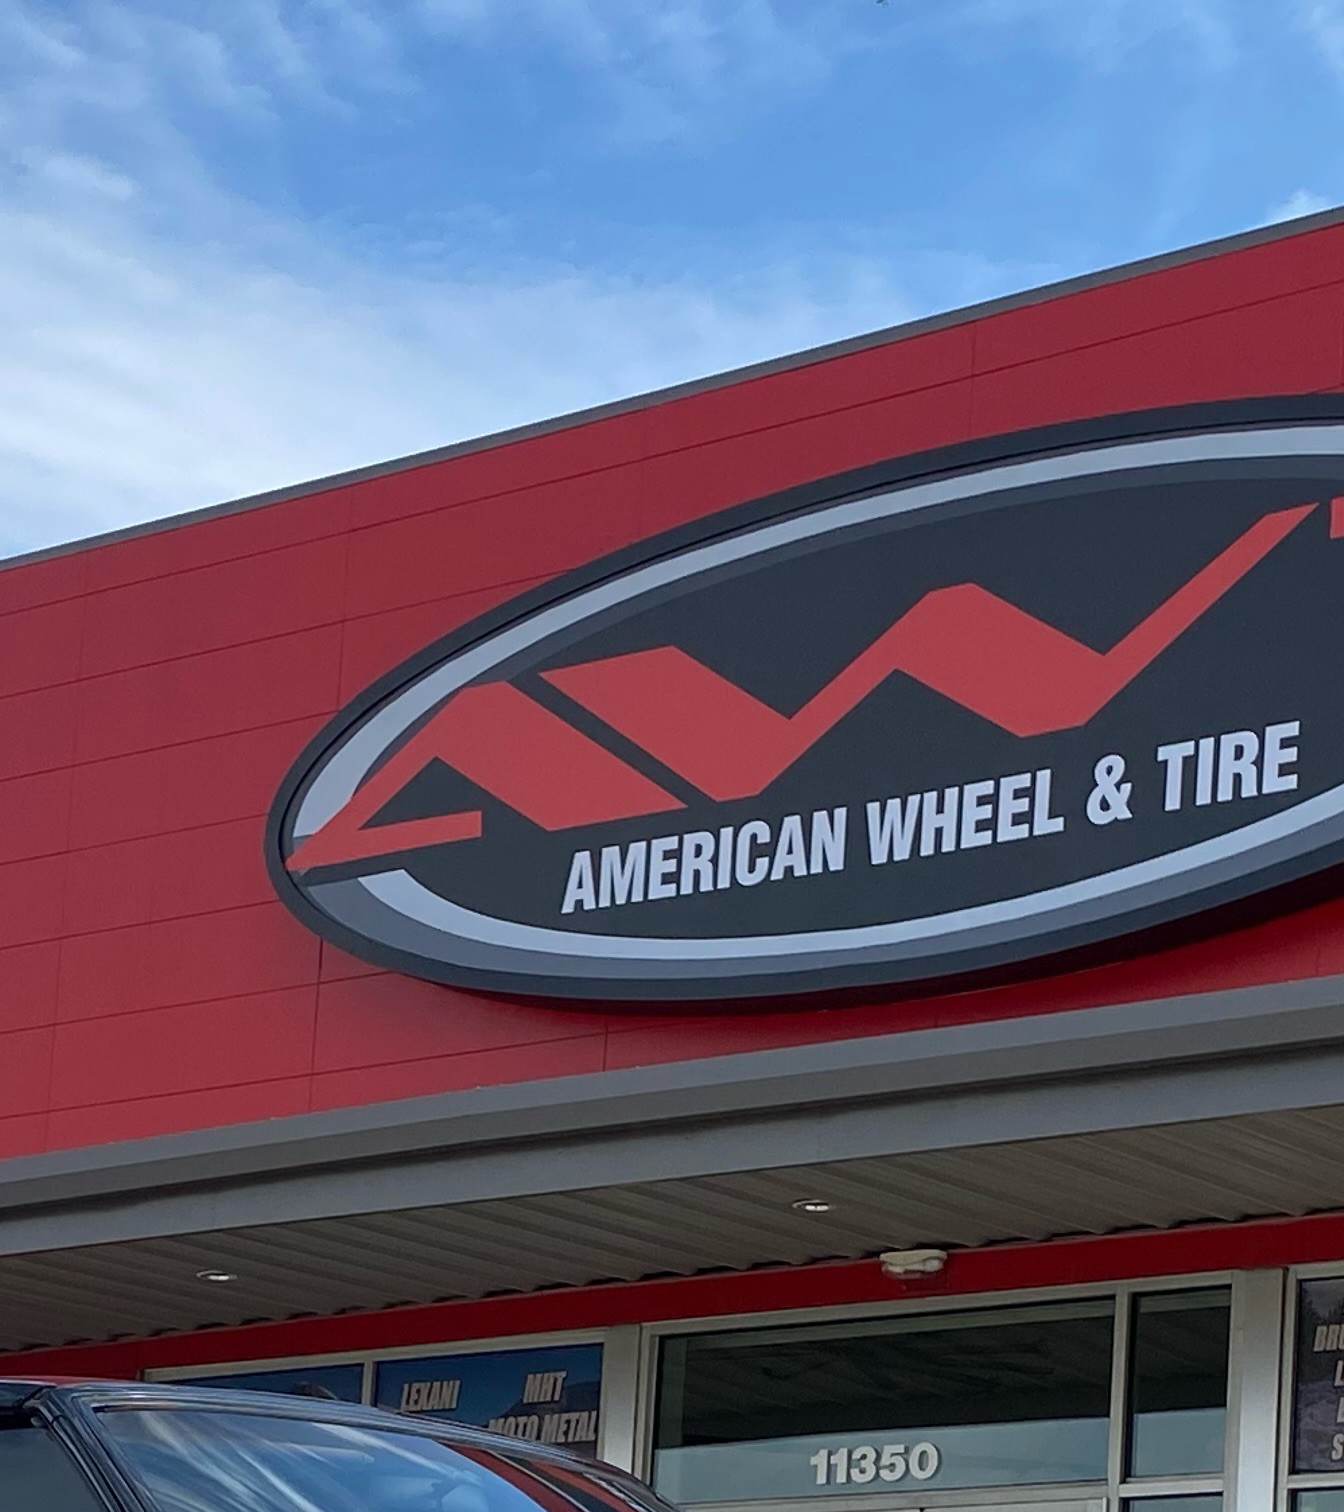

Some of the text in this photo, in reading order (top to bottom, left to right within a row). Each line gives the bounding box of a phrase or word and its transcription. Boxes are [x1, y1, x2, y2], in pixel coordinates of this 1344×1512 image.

[560, 720, 1301, 914] AMERICAN WHEEL & TIRE
[401, 1379, 462, 1412] LEXANI
[523, 1370, 569, 1404] MHT
[541, 1410, 599, 1444] METAL
[810, 1441, 939, 1486] 11350
